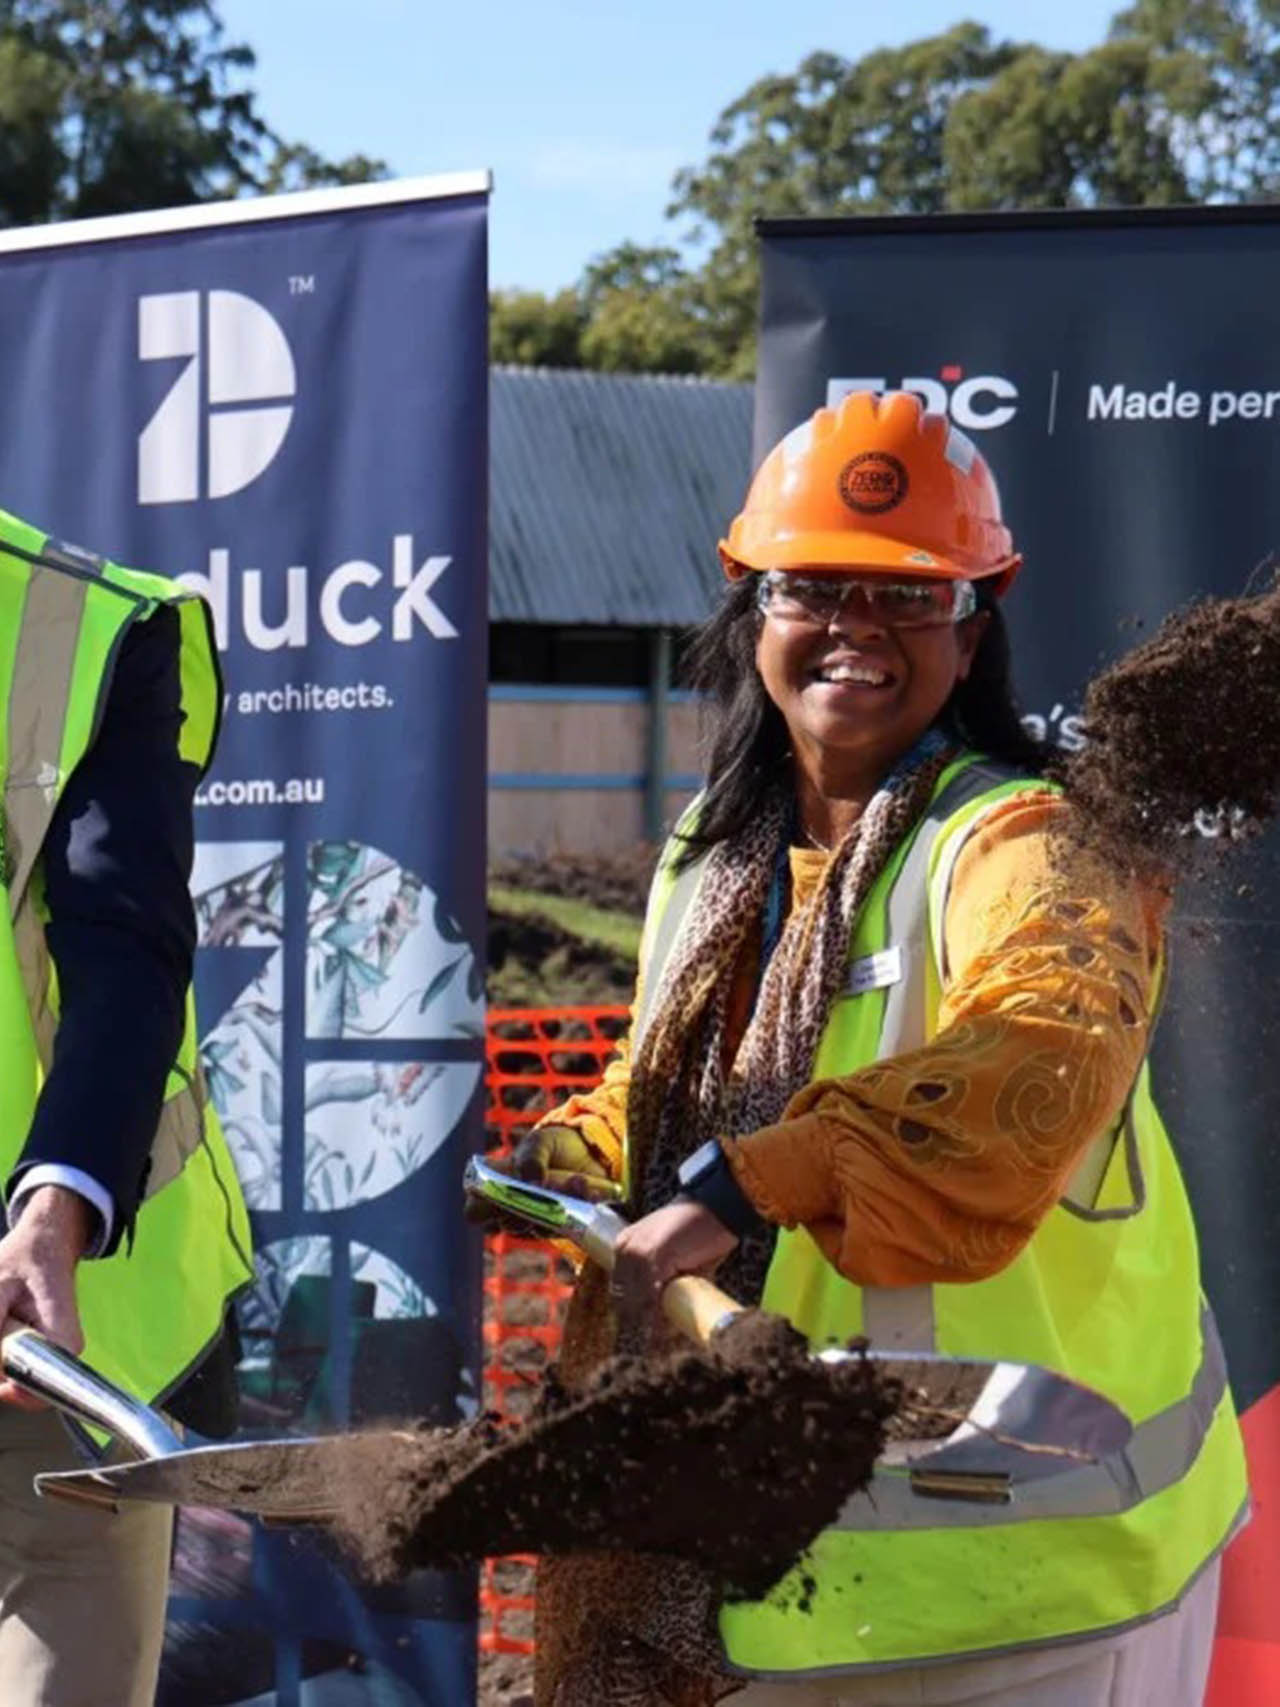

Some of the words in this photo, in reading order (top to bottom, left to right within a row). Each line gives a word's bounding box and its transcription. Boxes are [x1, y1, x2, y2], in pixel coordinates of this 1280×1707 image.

[288, 275, 315, 295] TM
[1087, 380, 1201, 421] Made
[1208, 390, 1280, 427] per
[237, 681, 395, 714] architects.
[194, 778, 325, 806] .com.au
